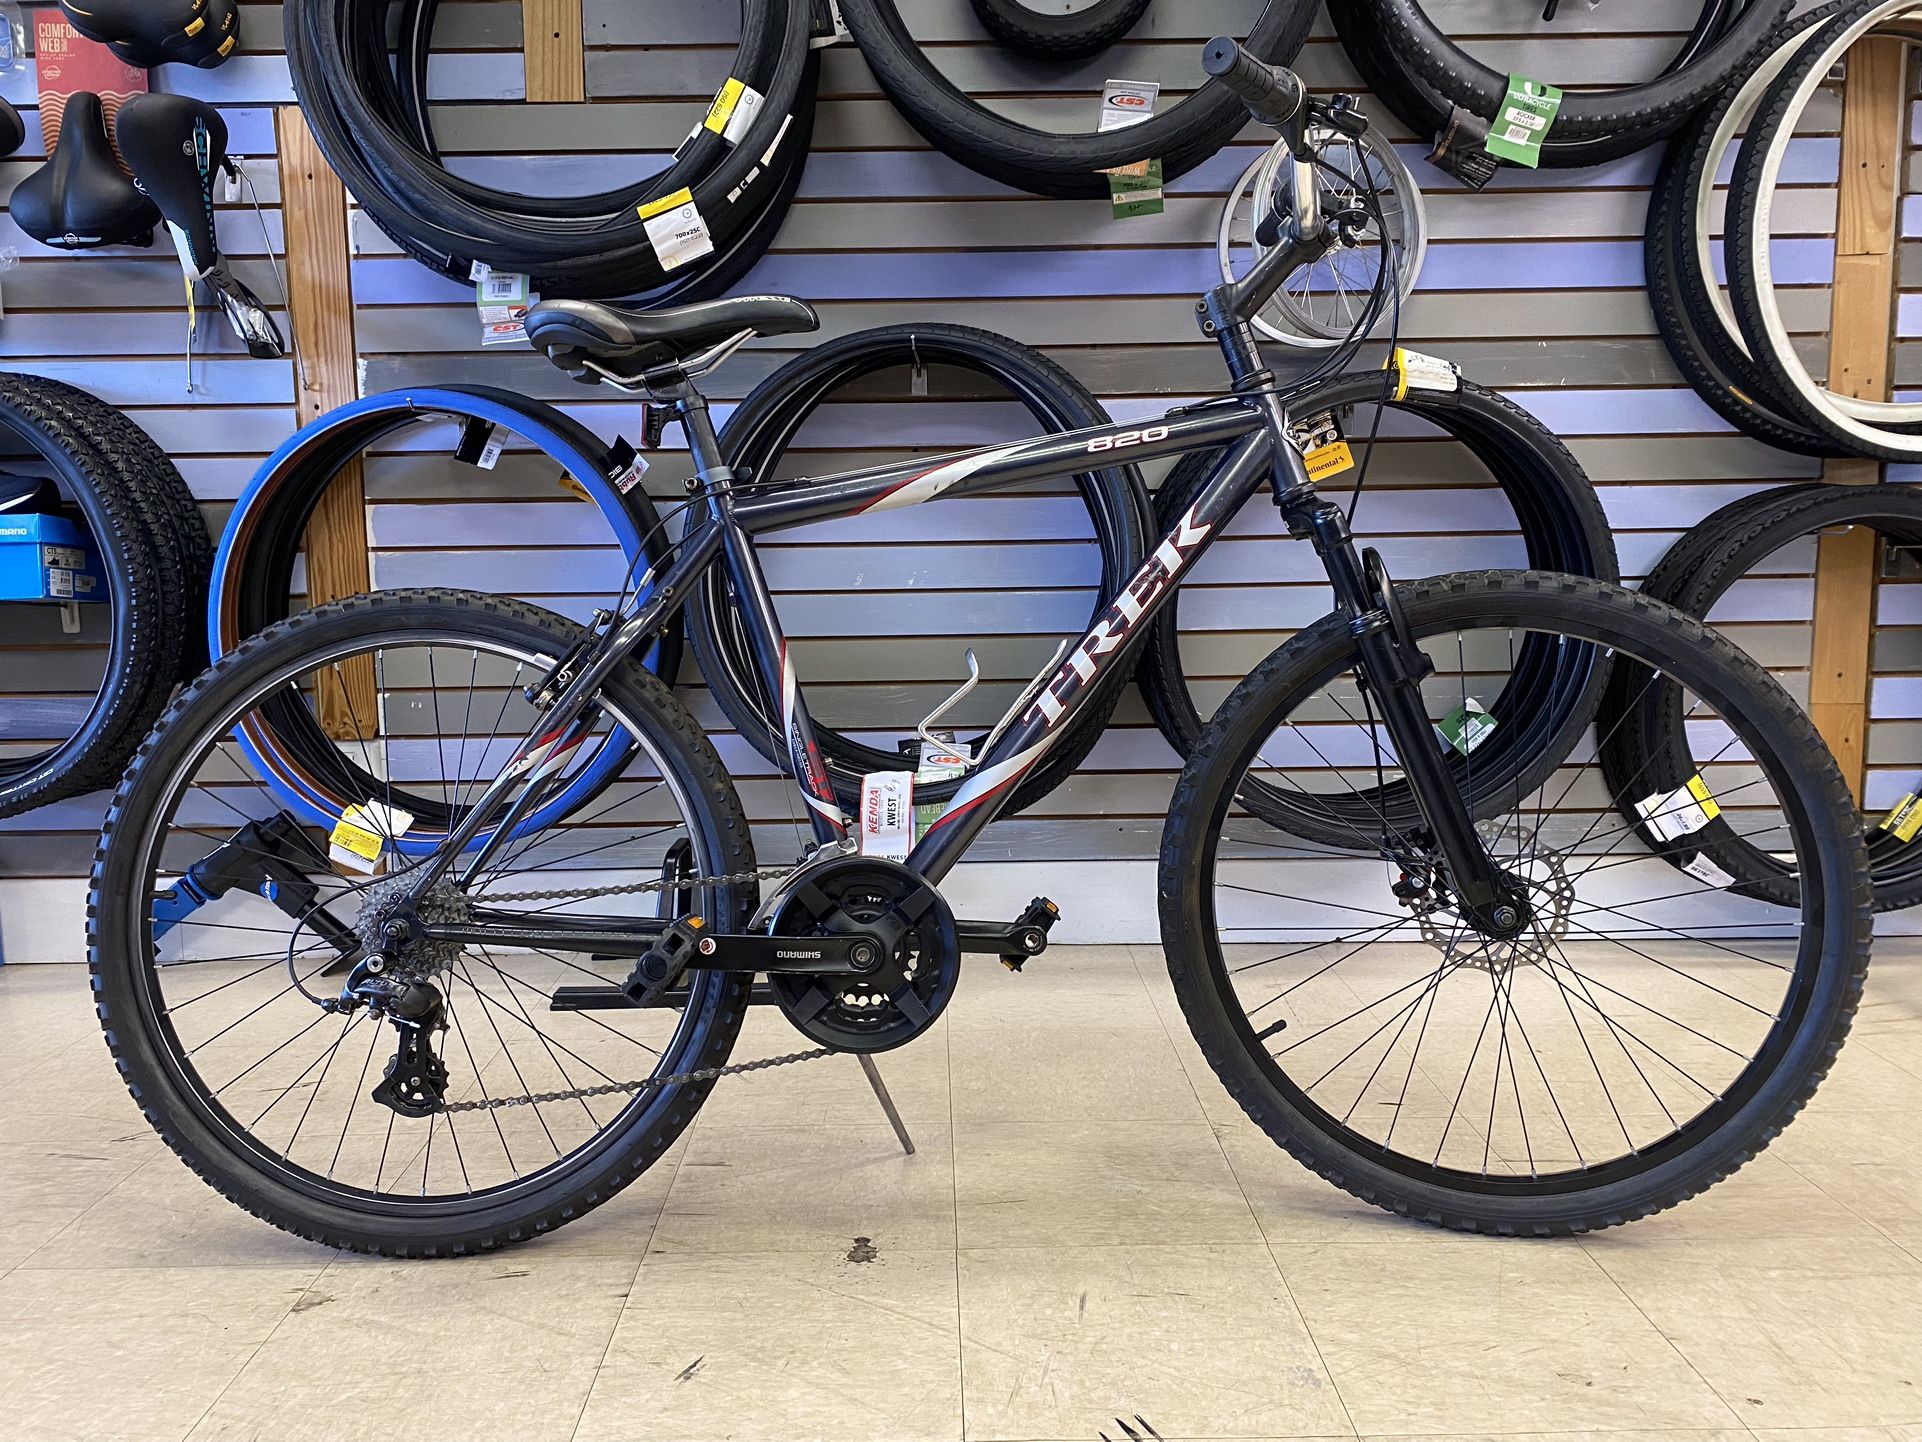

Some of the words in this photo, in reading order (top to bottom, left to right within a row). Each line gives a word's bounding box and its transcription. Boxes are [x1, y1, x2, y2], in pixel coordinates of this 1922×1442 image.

[40, 38, 60, 52] WEB
[1116, 98, 1145, 106] CST
[675, 226, 701, 240] 700x25C
[492, 324, 521, 332] CST
[1087, 426, 1168, 452] 820
[1306, 457, 1340, 475] ntinental
[0, 528, 28, 536] MANO
[1022, 504, 1212, 728] TREK
[868, 788, 881, 834] KENDA
[887, 798, 897, 826] KWEST
[776, 950, 821, 959] SHIMANO
